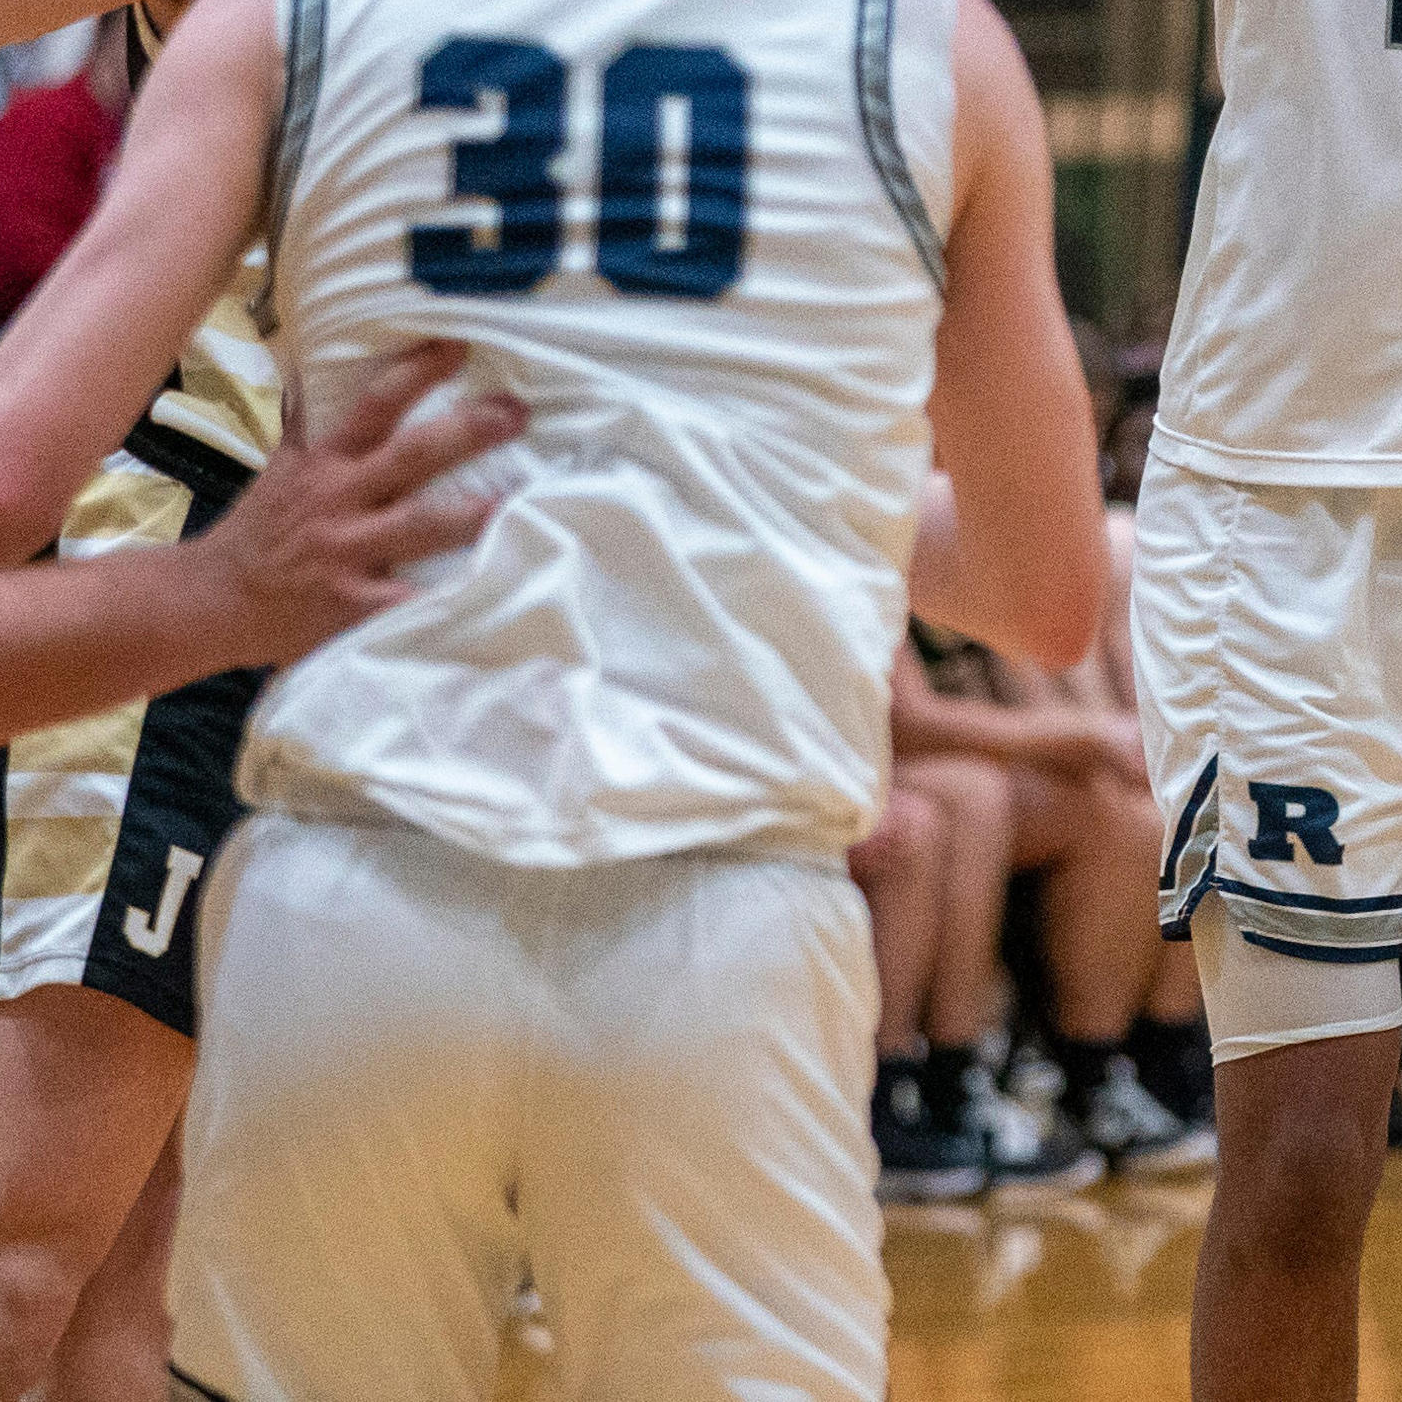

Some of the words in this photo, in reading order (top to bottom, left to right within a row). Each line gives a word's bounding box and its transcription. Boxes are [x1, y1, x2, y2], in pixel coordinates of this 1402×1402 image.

[409, 32, 751, 299] 30
[1247, 780, 1346, 867] R
[122, 844, 206, 959] J
